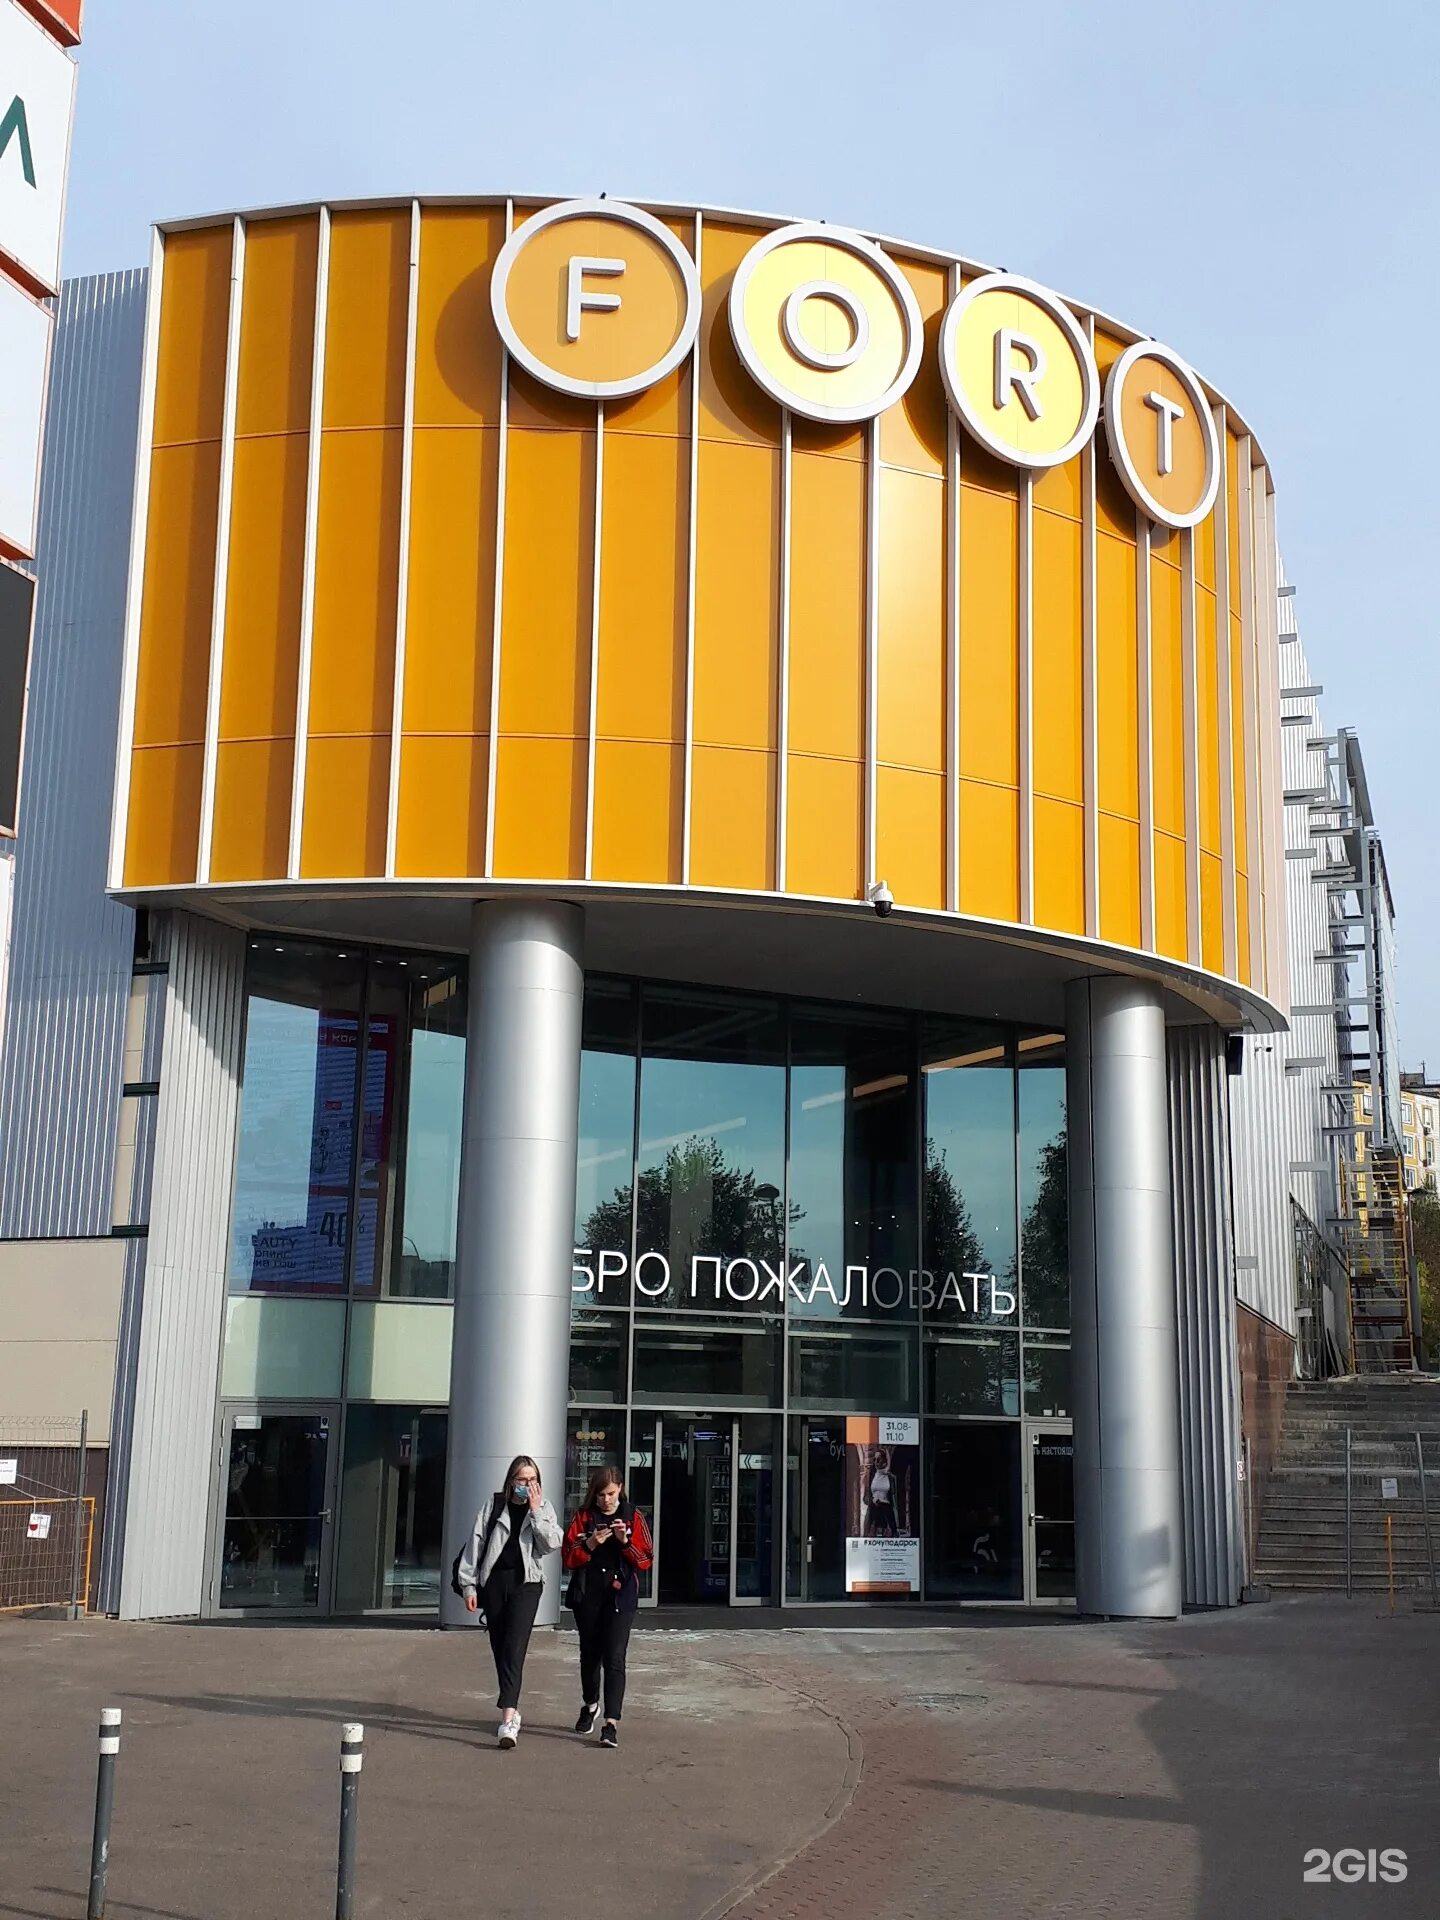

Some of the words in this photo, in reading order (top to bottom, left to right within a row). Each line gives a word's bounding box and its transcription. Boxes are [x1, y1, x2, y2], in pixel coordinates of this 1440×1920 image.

[565, 255, 1185, 475] FORT
[691, 1256, 1017, 1315] ПОЖАЛОВАТЬ
[886, 1421, 912, 1431] 31.08-
[886, 1432, 905, 1442] 11.10
[579, 1451, 602, 1461] 10-22
[863, 1539, 918, 1547] #хочуподарок
